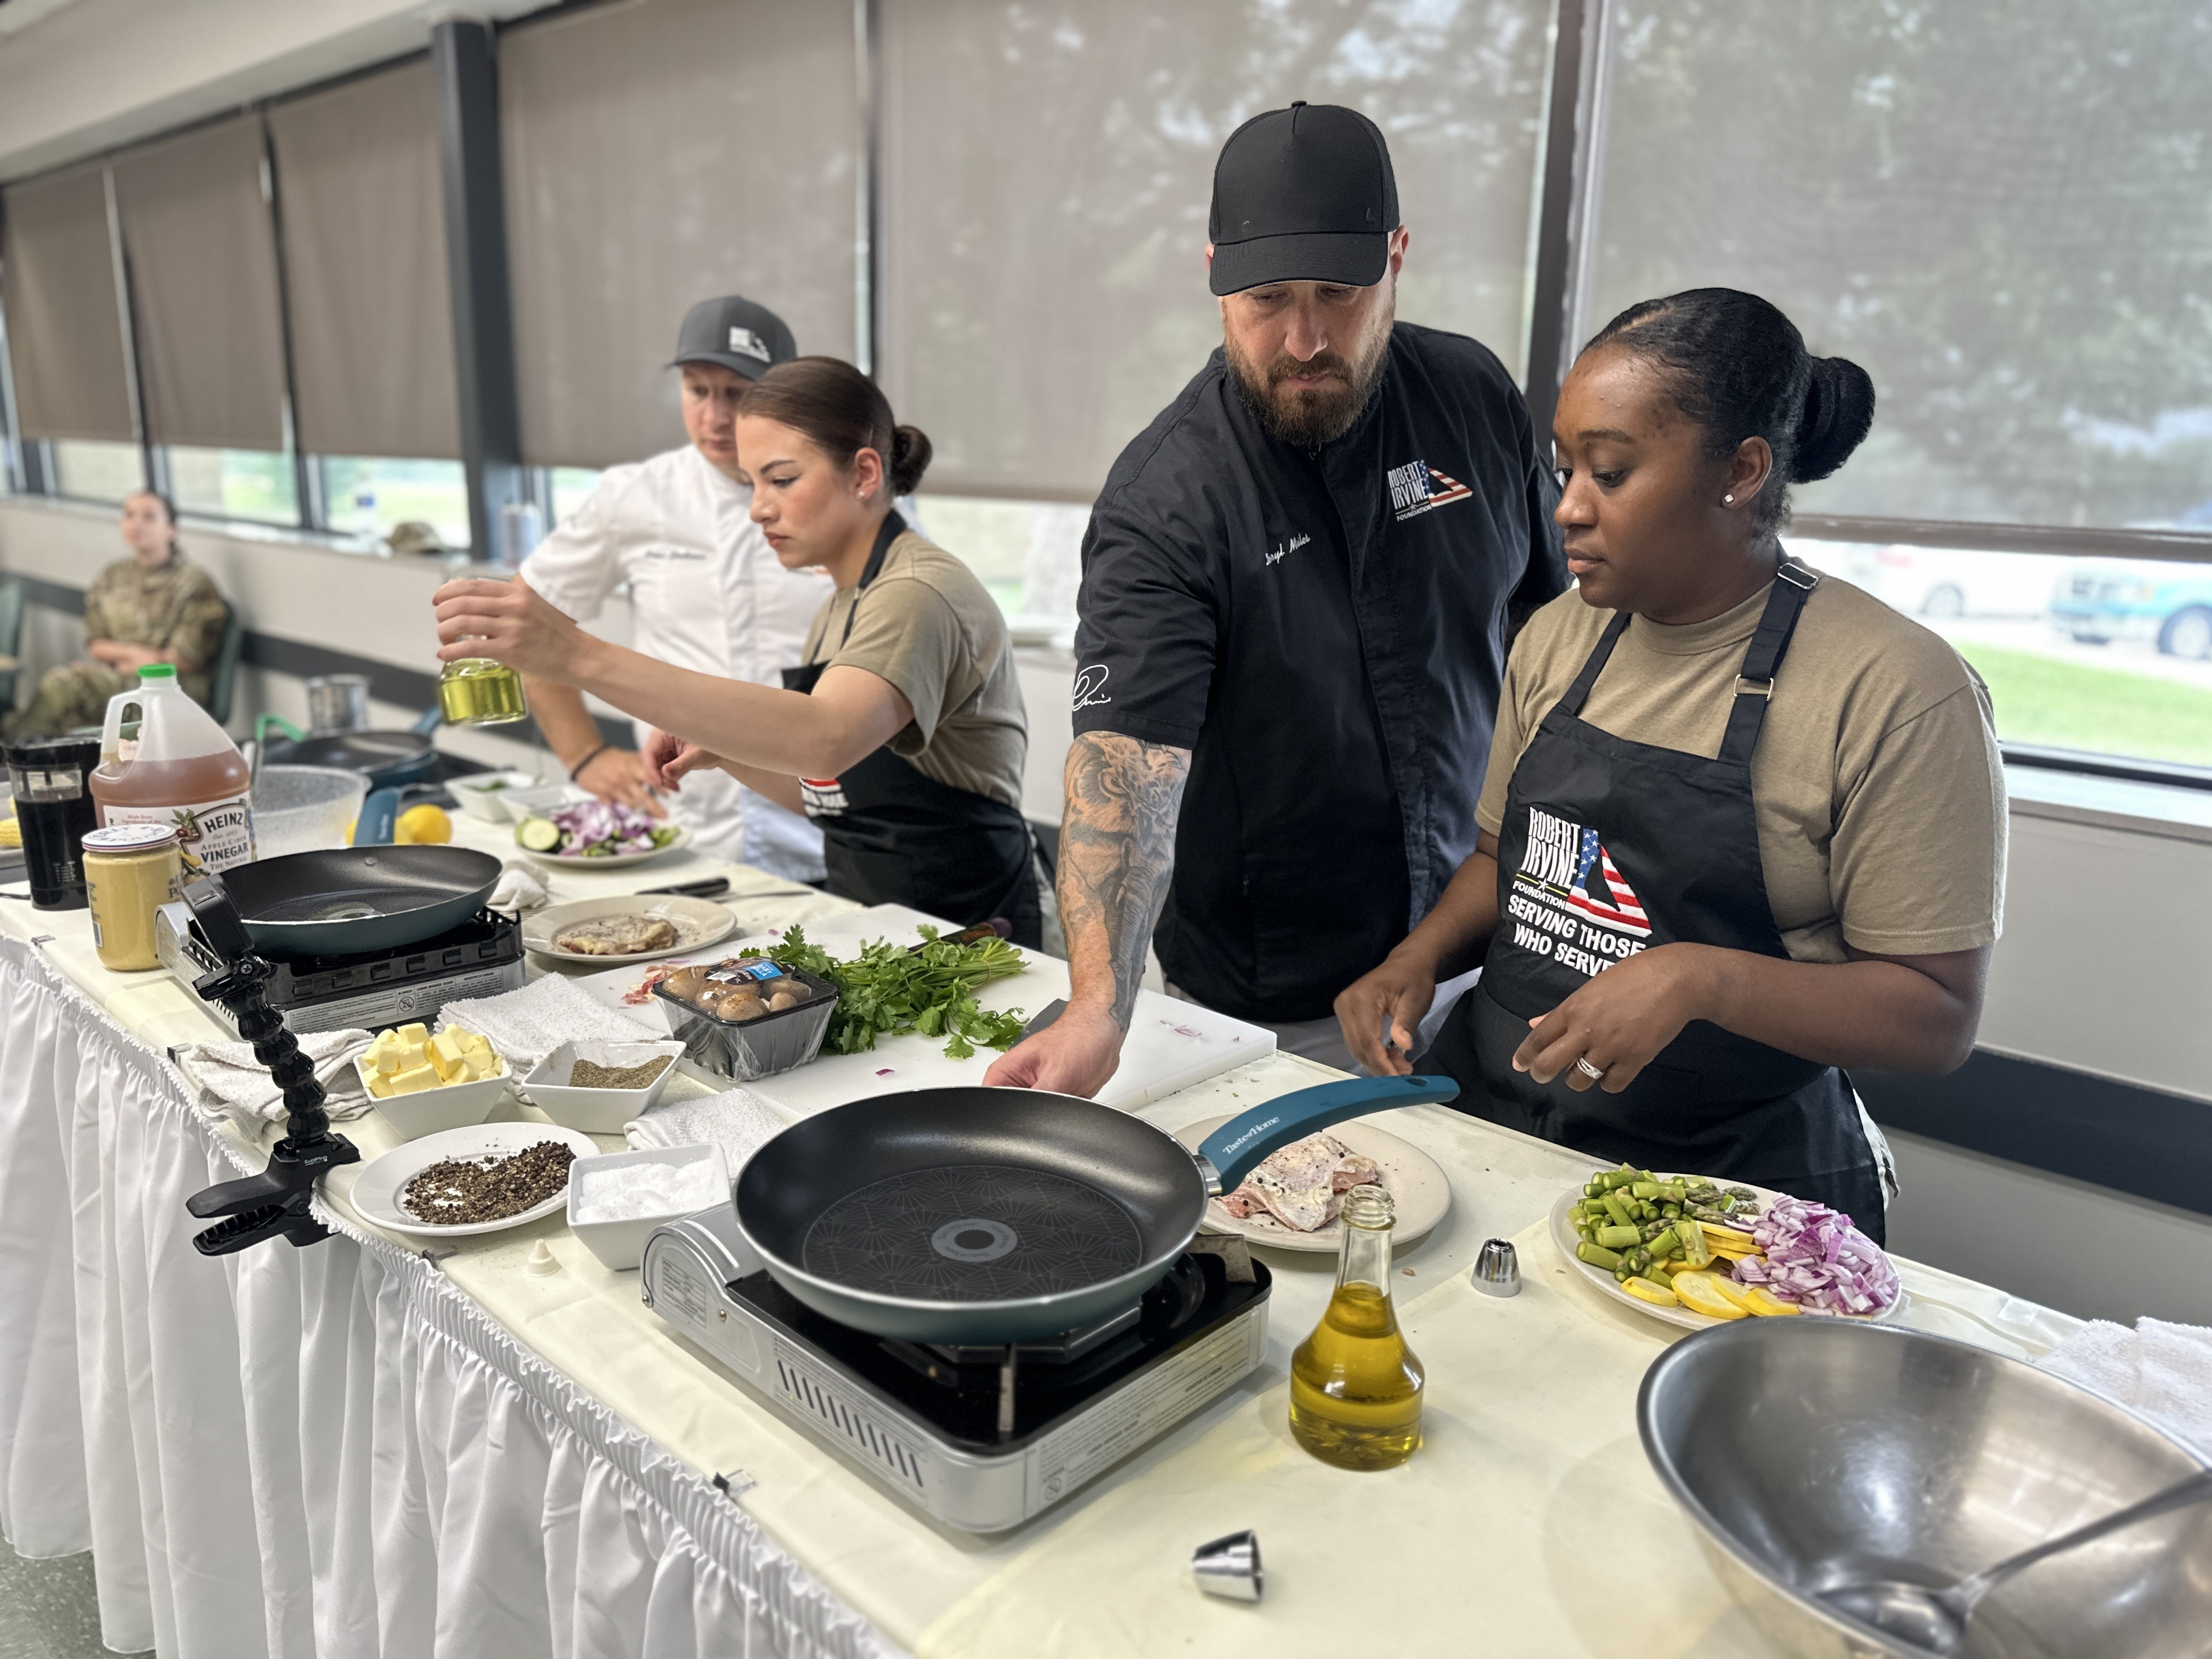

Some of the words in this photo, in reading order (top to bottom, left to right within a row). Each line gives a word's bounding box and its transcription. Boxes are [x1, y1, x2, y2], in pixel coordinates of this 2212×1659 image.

[1387, 461, 1421, 489] ROBERT
[1391, 478, 1429, 510] IRVINE
[1396, 504, 1432, 522] FOUNDATION
[204, 812, 243, 833] HEINZ
[1528, 806, 1581, 854] ROBERT
[200, 842, 249, 863] VINEGAR
[201, 841, 227, 851] APPLE
[228, 835, 246, 845] CIDER
[1520, 836, 1579, 890] IRVINE
[1512, 881, 1566, 910] FOUNDATION
[1508, 895, 1577, 938] SERVING
[1580, 924, 1646, 959] THOSE
[1513, 922, 1552, 956] WHO
